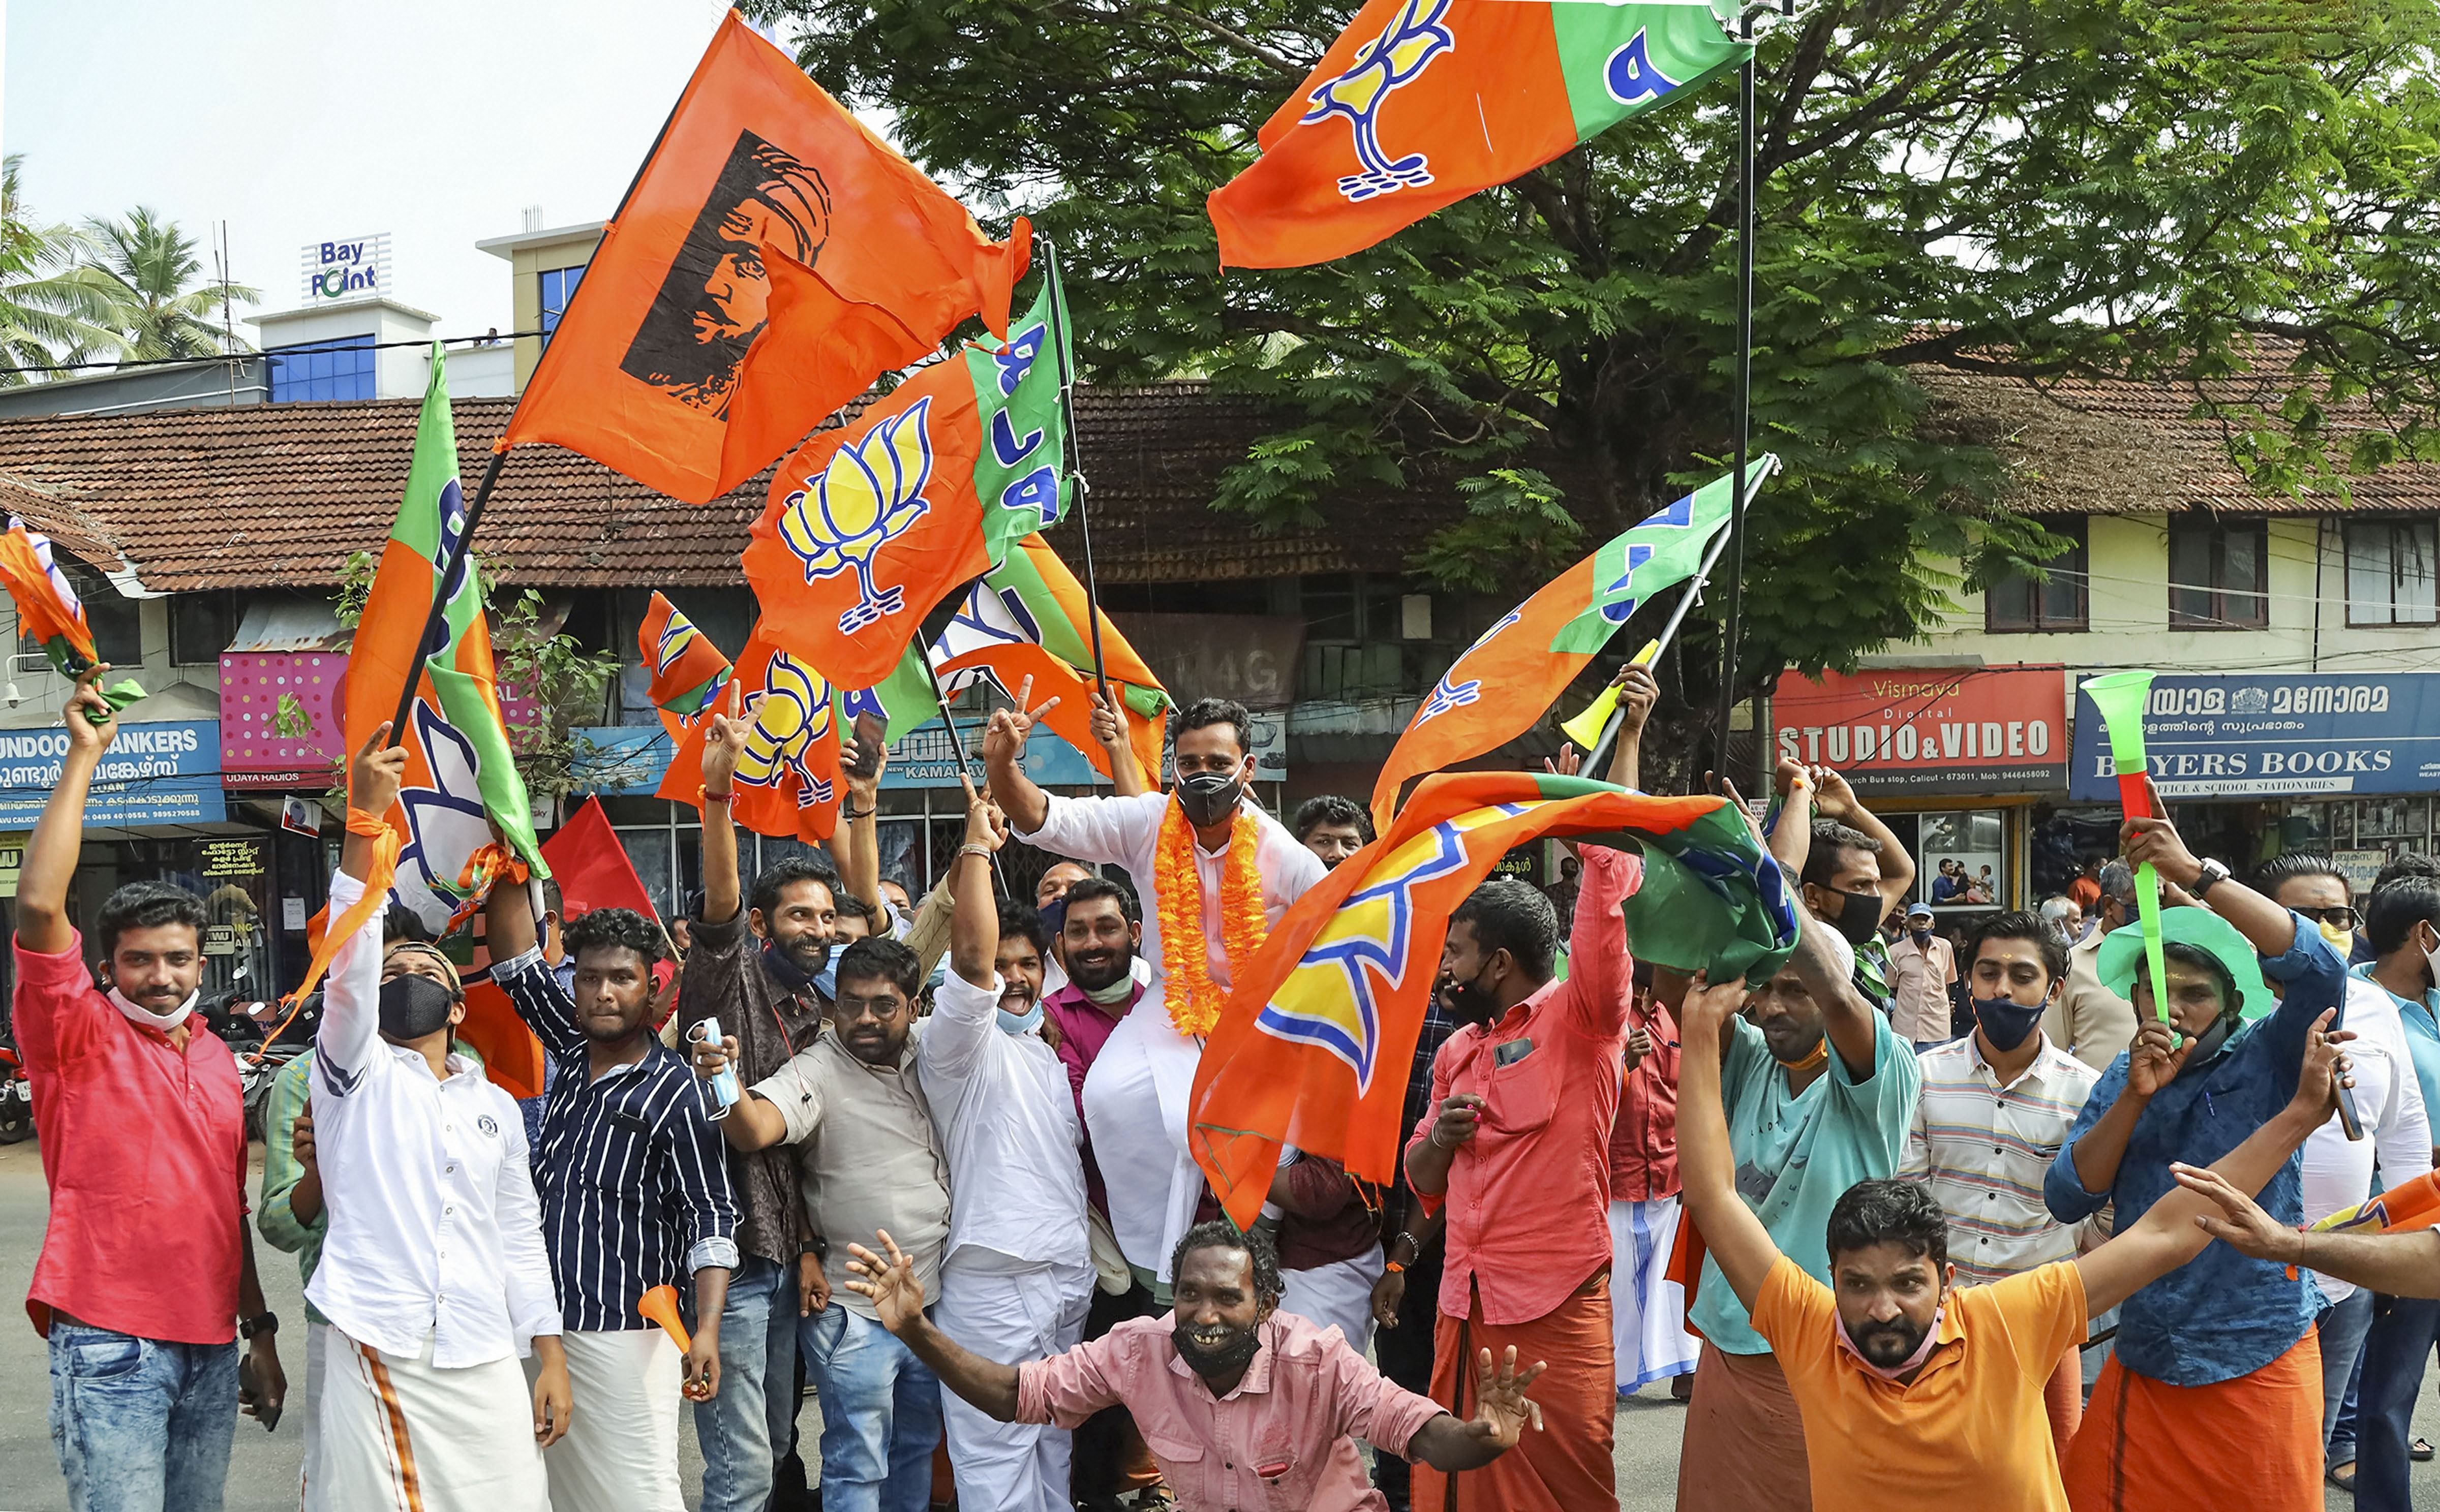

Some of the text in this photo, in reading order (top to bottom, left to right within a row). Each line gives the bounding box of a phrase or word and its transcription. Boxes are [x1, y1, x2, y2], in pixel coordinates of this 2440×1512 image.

[321, 242, 364, 265] Bay
[312, 265, 375, 298] Point
[495, 686, 518, 702] AL
[1873, 680, 1960, 701] Vismaya
[2271, 686, 2389, 714] മനോരമ
[1884, 707, 1954, 722] Digital
[2221, 721, 2305, 734] സുപ്രഭാതം
[104, 729, 198, 755] ANKERS
[2094, 749, 2392, 778] BYERS BOOKS
[226, 774, 260, 783] UDAYA
[1845, 776, 1867, 784] urch
[1910, 774, 1939, 783] Calicut
[1980, 772, 2000, 780] Mob:
[2002, 769, 2050, 780] 9446458092
[2157, 780, 2335, 793] FFICE & SCHOOL STATIONARIES
[12, 816, 40, 824] CALICUT
[234, 923, 253, 932] ING
